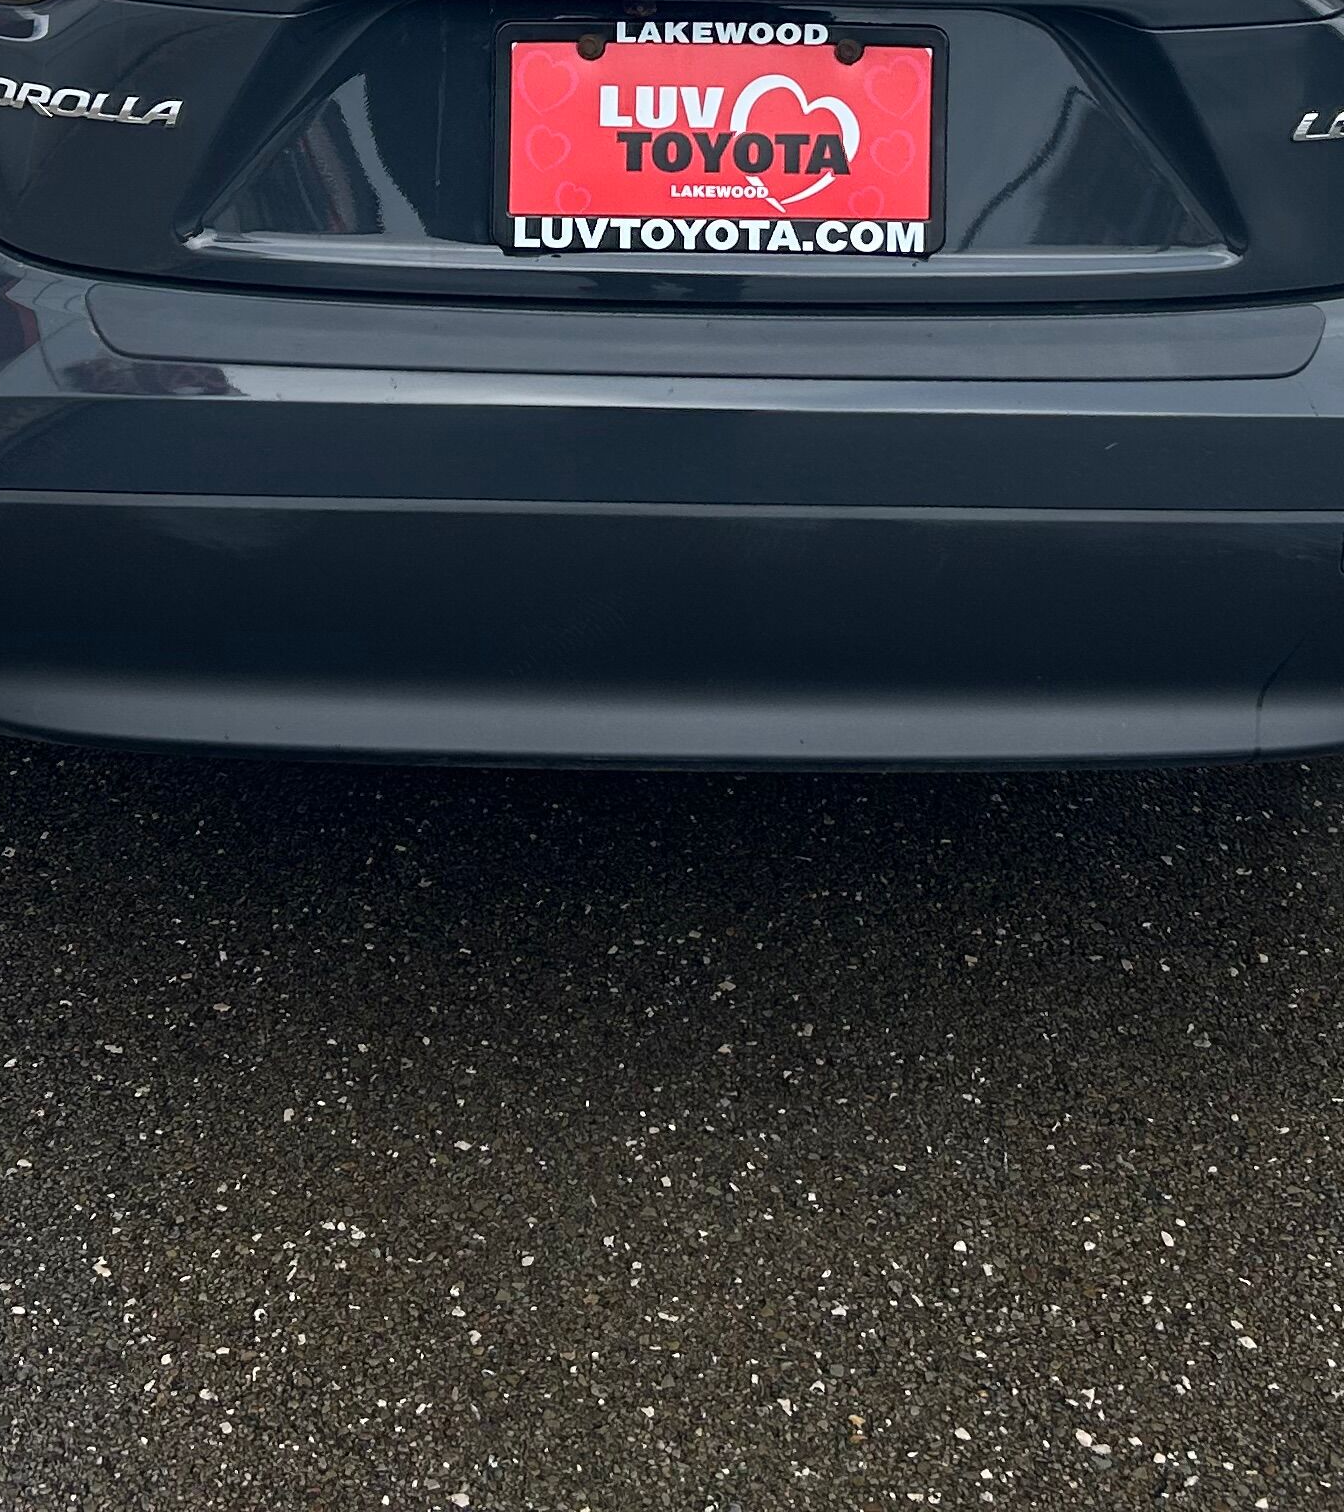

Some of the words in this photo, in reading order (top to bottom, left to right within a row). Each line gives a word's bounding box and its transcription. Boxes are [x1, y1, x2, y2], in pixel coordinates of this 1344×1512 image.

[616, 21, 830, 46] LAKEWOOD
[599, 84, 725, 130] LUV
[616, 130, 851, 176] TOYOTA
[670, 184, 770, 200] LAKEWOOD
[513, 216, 925, 254] LUVTOYOTA.COM
